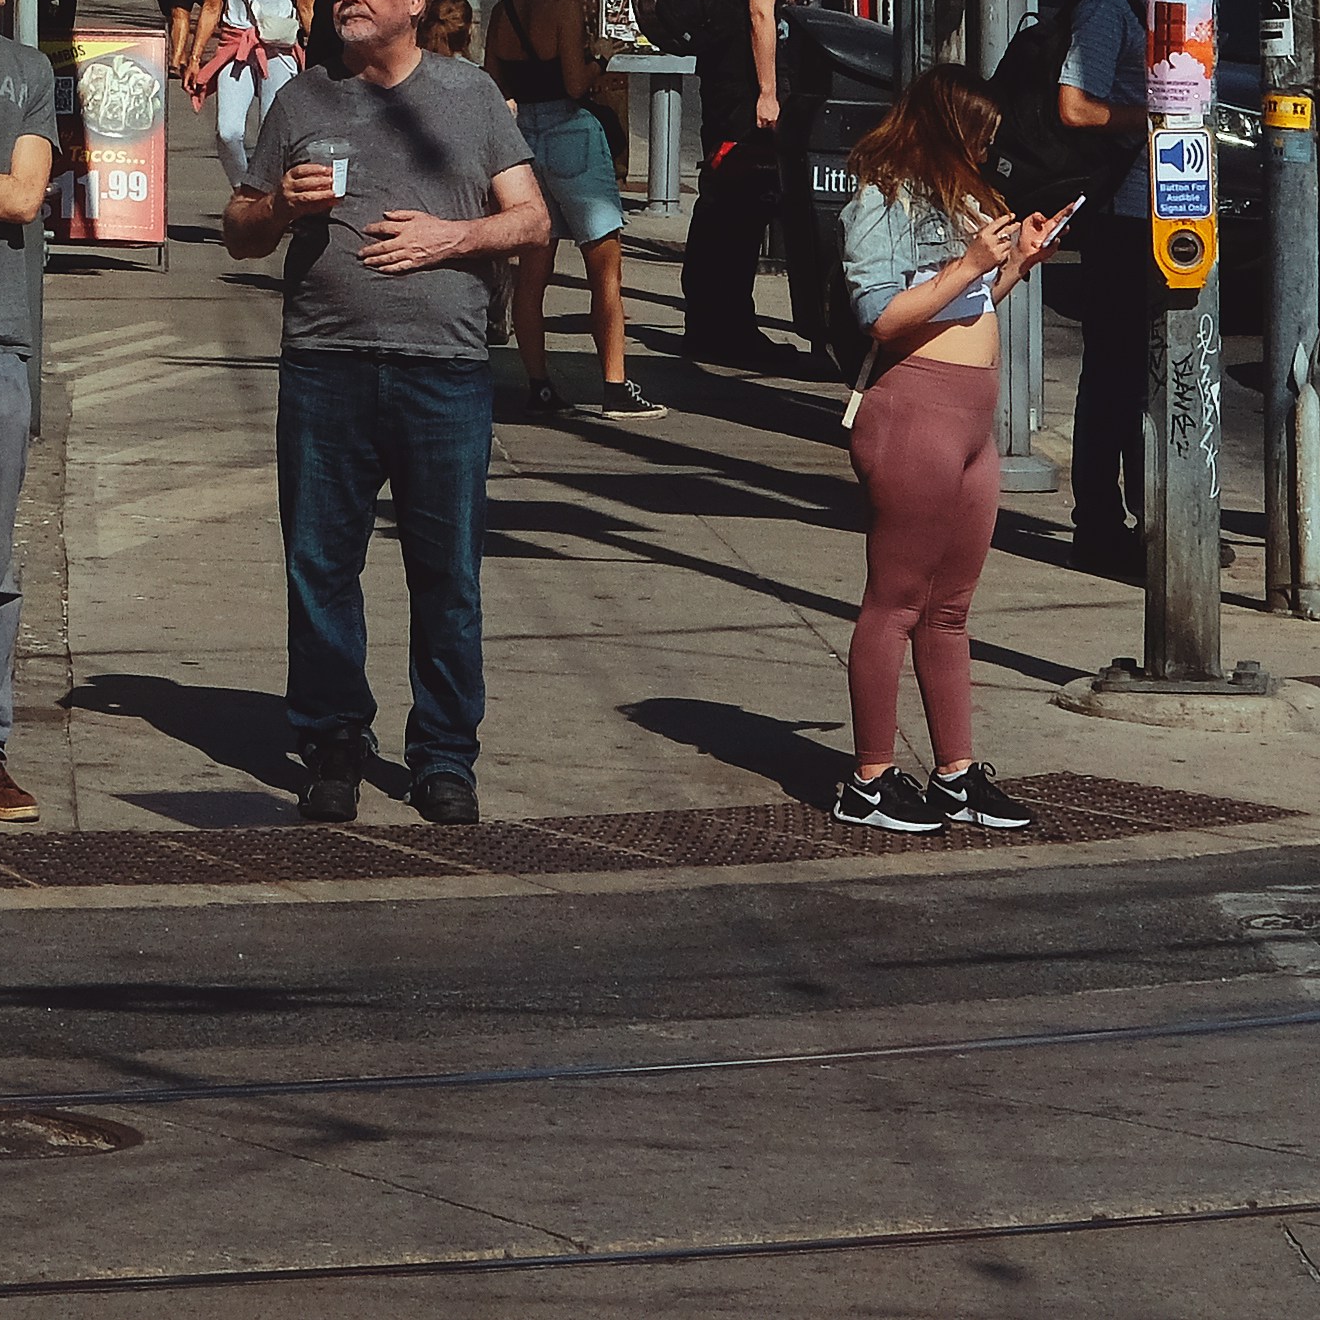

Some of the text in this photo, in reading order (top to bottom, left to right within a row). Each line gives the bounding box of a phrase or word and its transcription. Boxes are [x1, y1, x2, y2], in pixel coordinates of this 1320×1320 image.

[51, 44, 87, 63] MBOS
[1160, 183, 1207, 192] Button For
[1166, 192, 1201, 202] Audible
[1160, 203, 1208, 214] Signal Only
